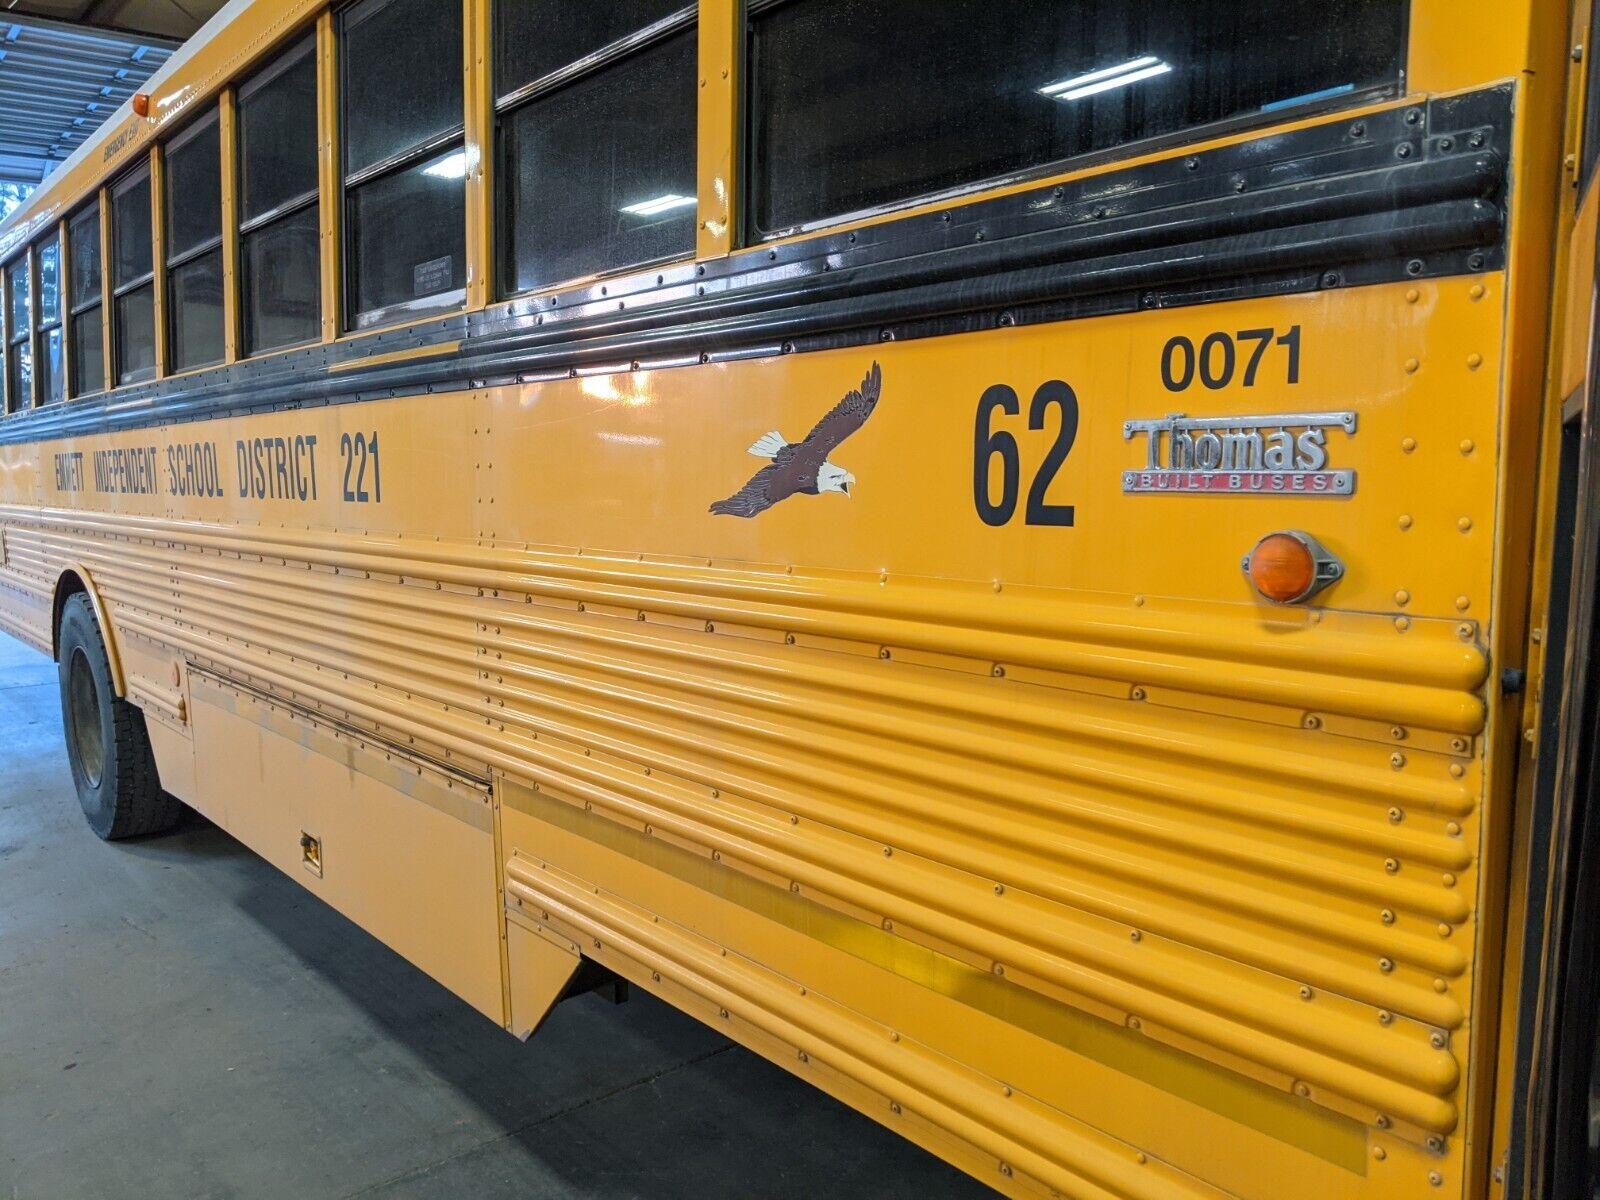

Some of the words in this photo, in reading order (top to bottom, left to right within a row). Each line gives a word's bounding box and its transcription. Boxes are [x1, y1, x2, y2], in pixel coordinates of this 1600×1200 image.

[1160, 324, 1302, 393] 0071
[93, 446, 158, 495] INDEPENDENT
[167, 441, 224, 498] SCHOOL
[236, 434, 317, 502] DISTRICT
[340, 430, 381, 503] 221
[973, 379, 1080, 528] 62
[1123, 411, 1357, 471] Thomas
[1139, 473, 1215, 490] BUILT
[1228, 474, 1328, 491] BUSES
